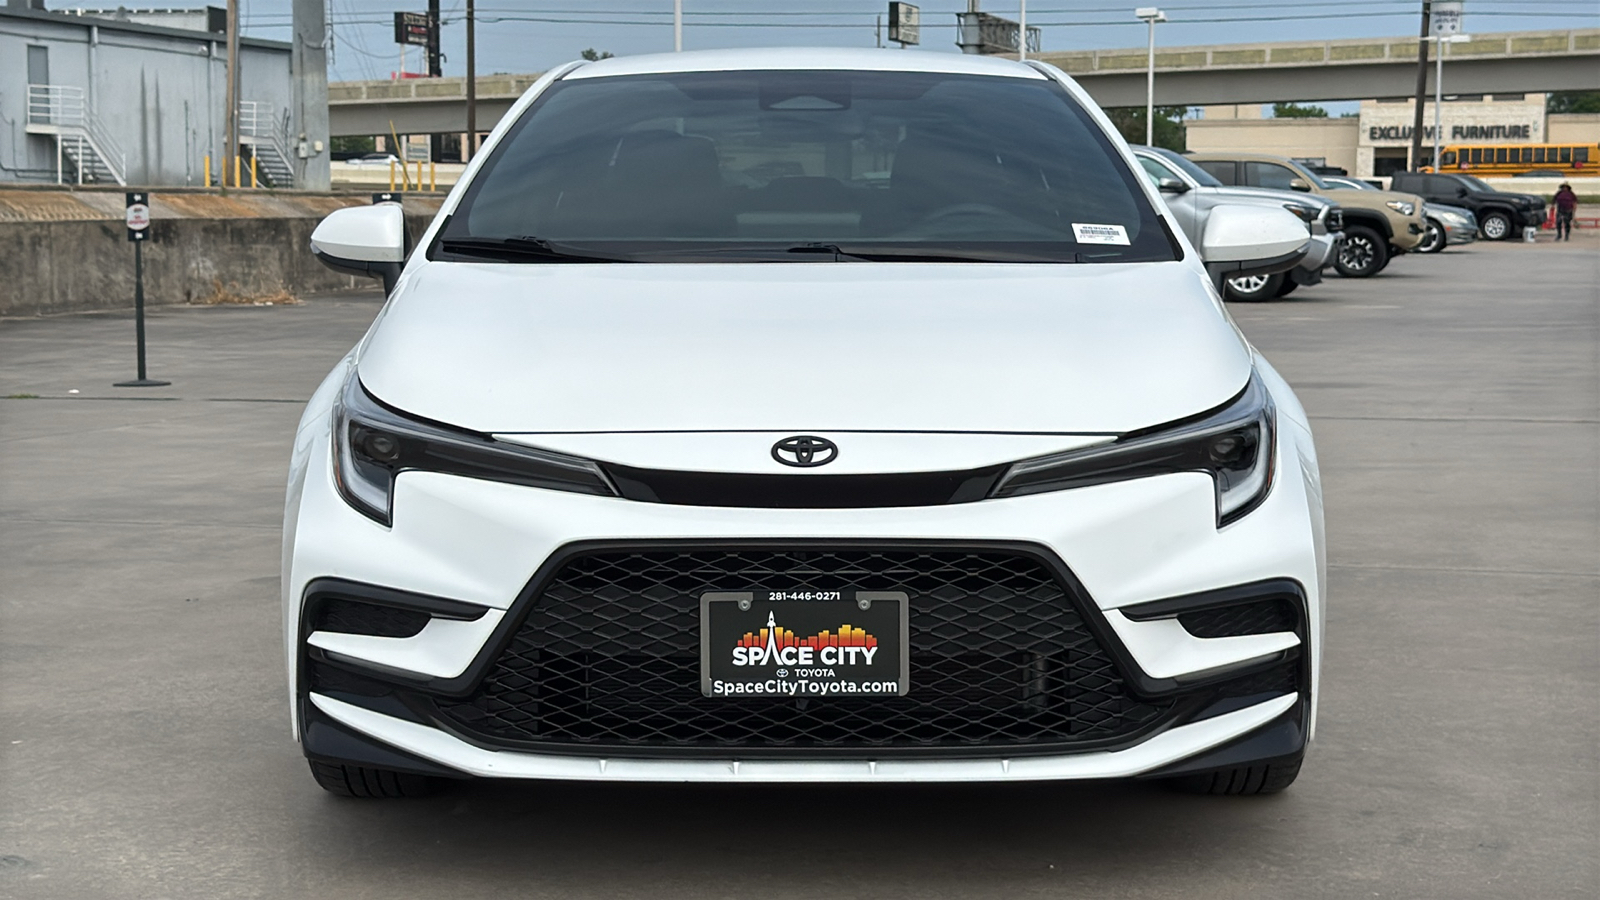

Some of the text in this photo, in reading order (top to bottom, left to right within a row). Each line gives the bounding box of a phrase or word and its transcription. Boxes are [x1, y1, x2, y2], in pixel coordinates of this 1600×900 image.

[1370, 125, 1529, 140] EXCLUVE FURNITURE
[769, 592, 840, 600] 281-446-0271
[733, 628, 878, 665] SPACE CITY
[795, 669, 835, 677] TOYOTA
[713, 680, 897, 696] SpaceCityToyota.com
